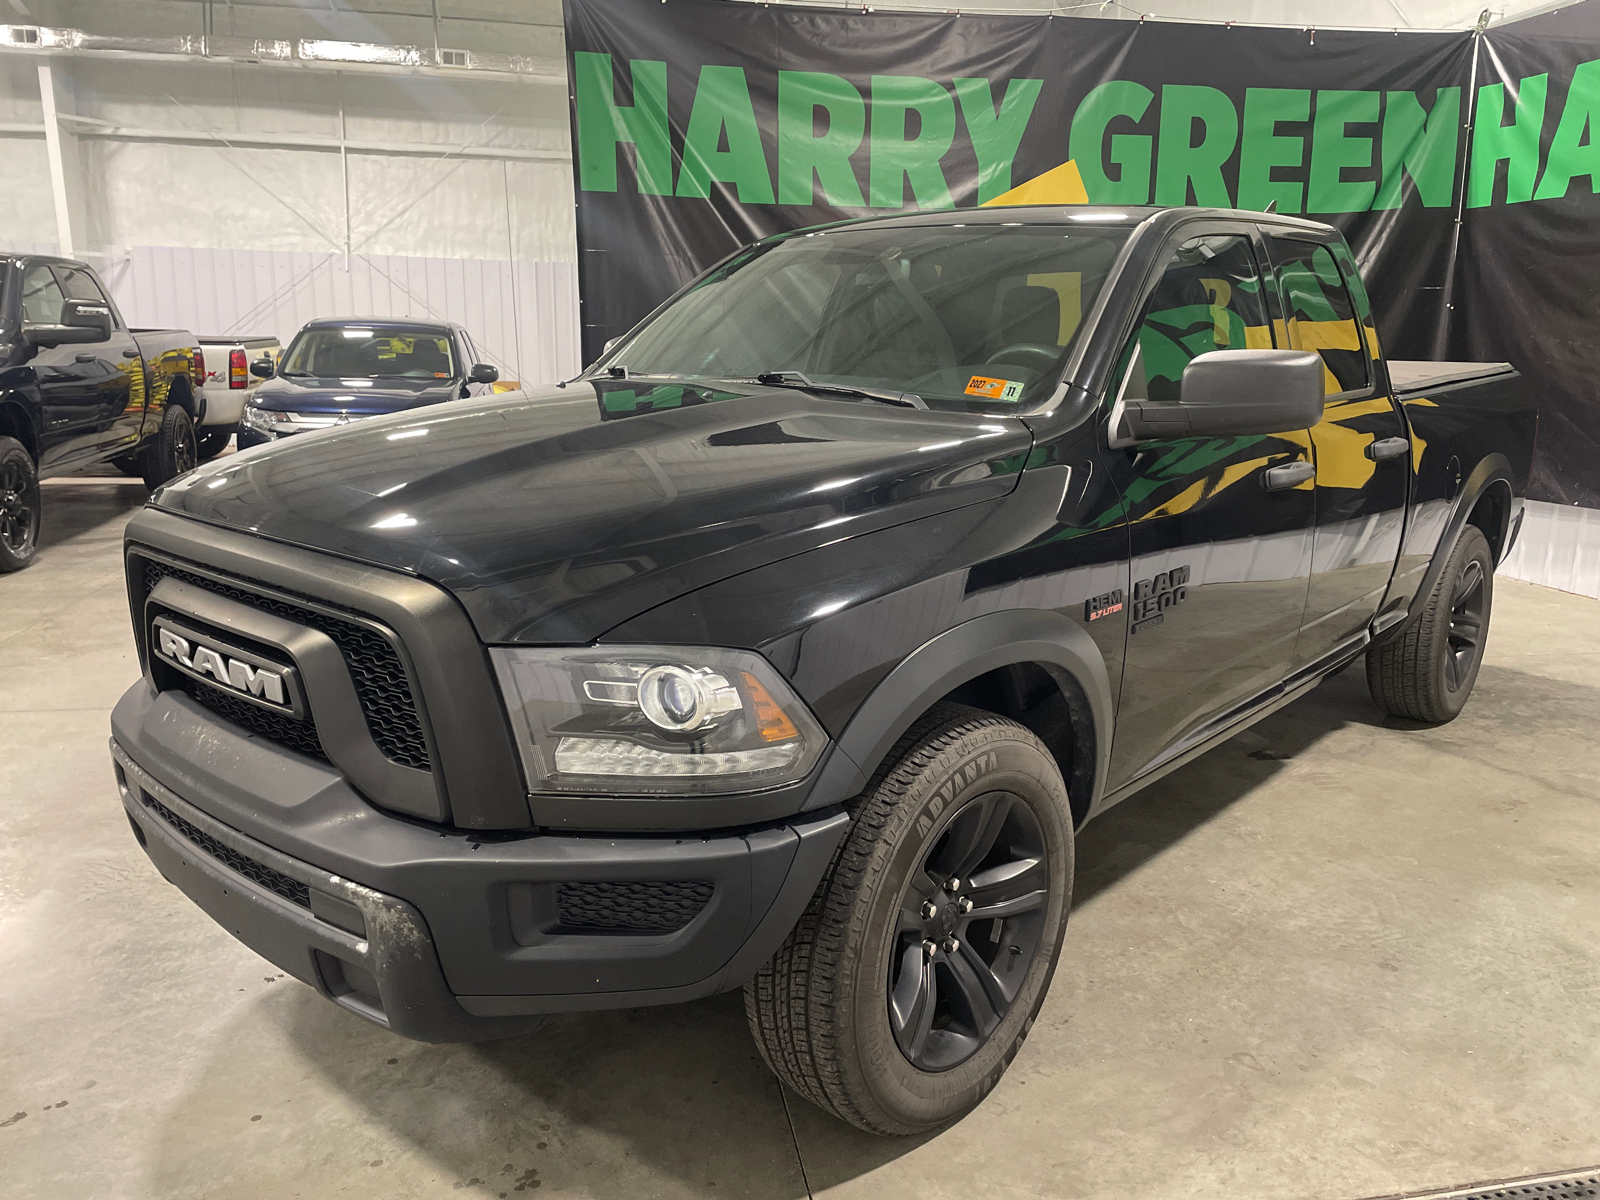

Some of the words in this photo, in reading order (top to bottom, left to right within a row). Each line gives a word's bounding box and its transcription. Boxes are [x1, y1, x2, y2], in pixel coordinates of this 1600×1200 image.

[574, 51, 1044, 208] HARRY
[1068, 80, 1461, 214] GREEN
[1466, 58, 1600, 209] HA
[969, 379, 986, 389] 2027
[1007, 386, 1016, 397] 11
[1133, 586, 1188, 621] 1500
[1134, 565, 1190, 601] RAM
[1090, 609, 1103, 620] 5.7
[1103, 603, 1122, 616] LITER
[160, 627, 284, 704] RAM
[916, 751, 998, 840] ADVANTA
